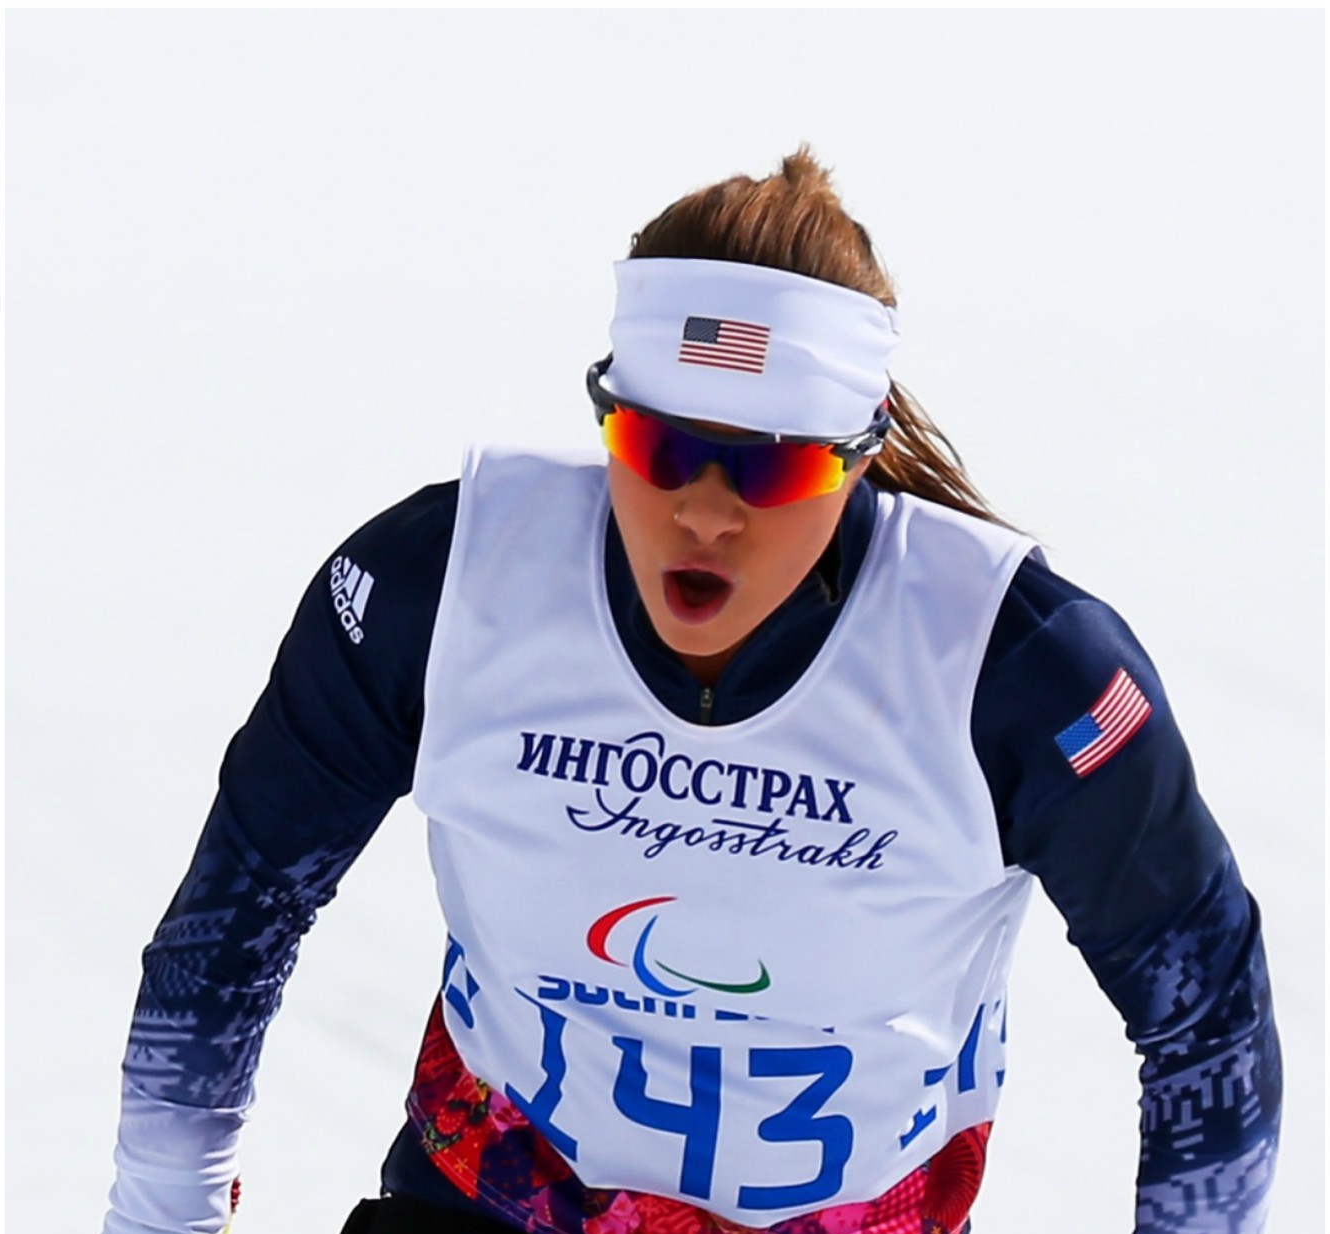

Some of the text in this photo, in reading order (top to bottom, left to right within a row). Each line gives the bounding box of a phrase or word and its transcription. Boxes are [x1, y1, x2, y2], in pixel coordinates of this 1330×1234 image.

[329, 555, 365, 645] adidas
[517, 732, 856, 824] ИНГОССТРАХ
[565, 793, 899, 871] Ingosstrakh
[505, 988, 854, 1211] 143
